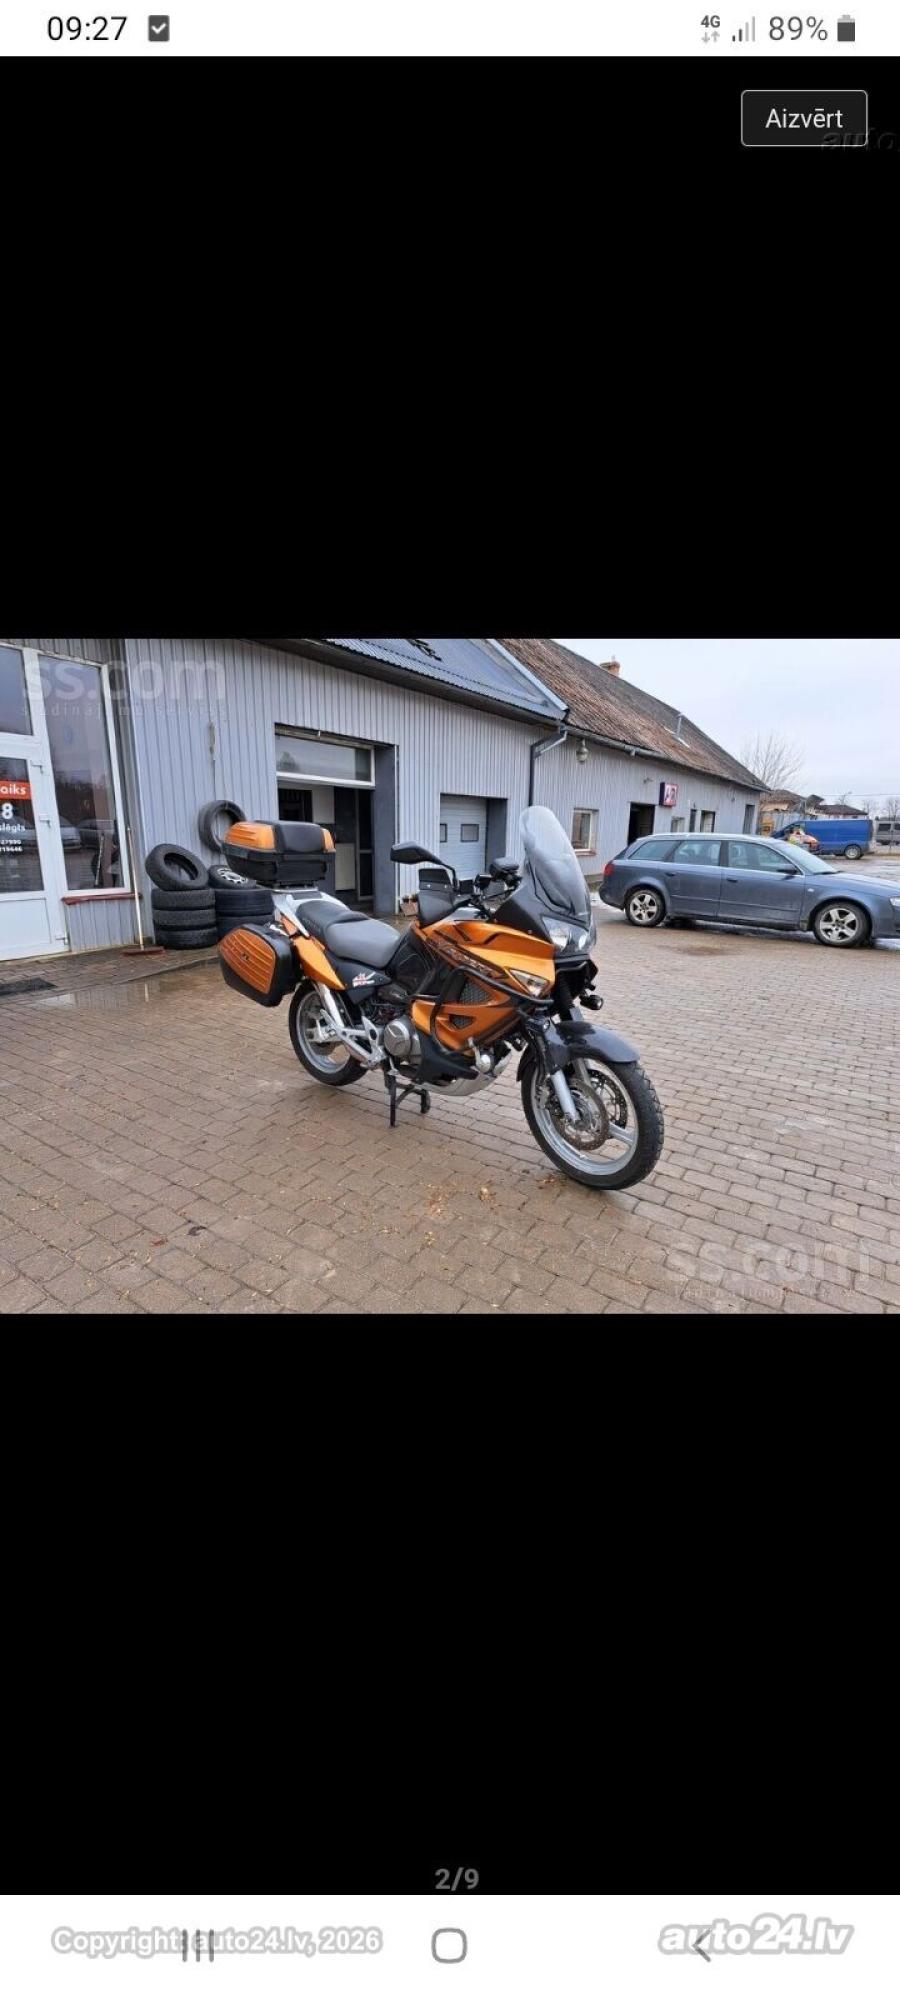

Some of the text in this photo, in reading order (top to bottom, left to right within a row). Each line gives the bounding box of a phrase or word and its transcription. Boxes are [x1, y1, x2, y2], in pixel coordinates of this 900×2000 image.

[47, 15, 128, 41] 09:27
[700, 14, 721, 29] 4G
[769, 15, 828, 41] 89%
[765, 107, 844, 129] Aizvērt
[1, 802, 14, 819] 8
[434, 1866, 480, 1891] 2/9
